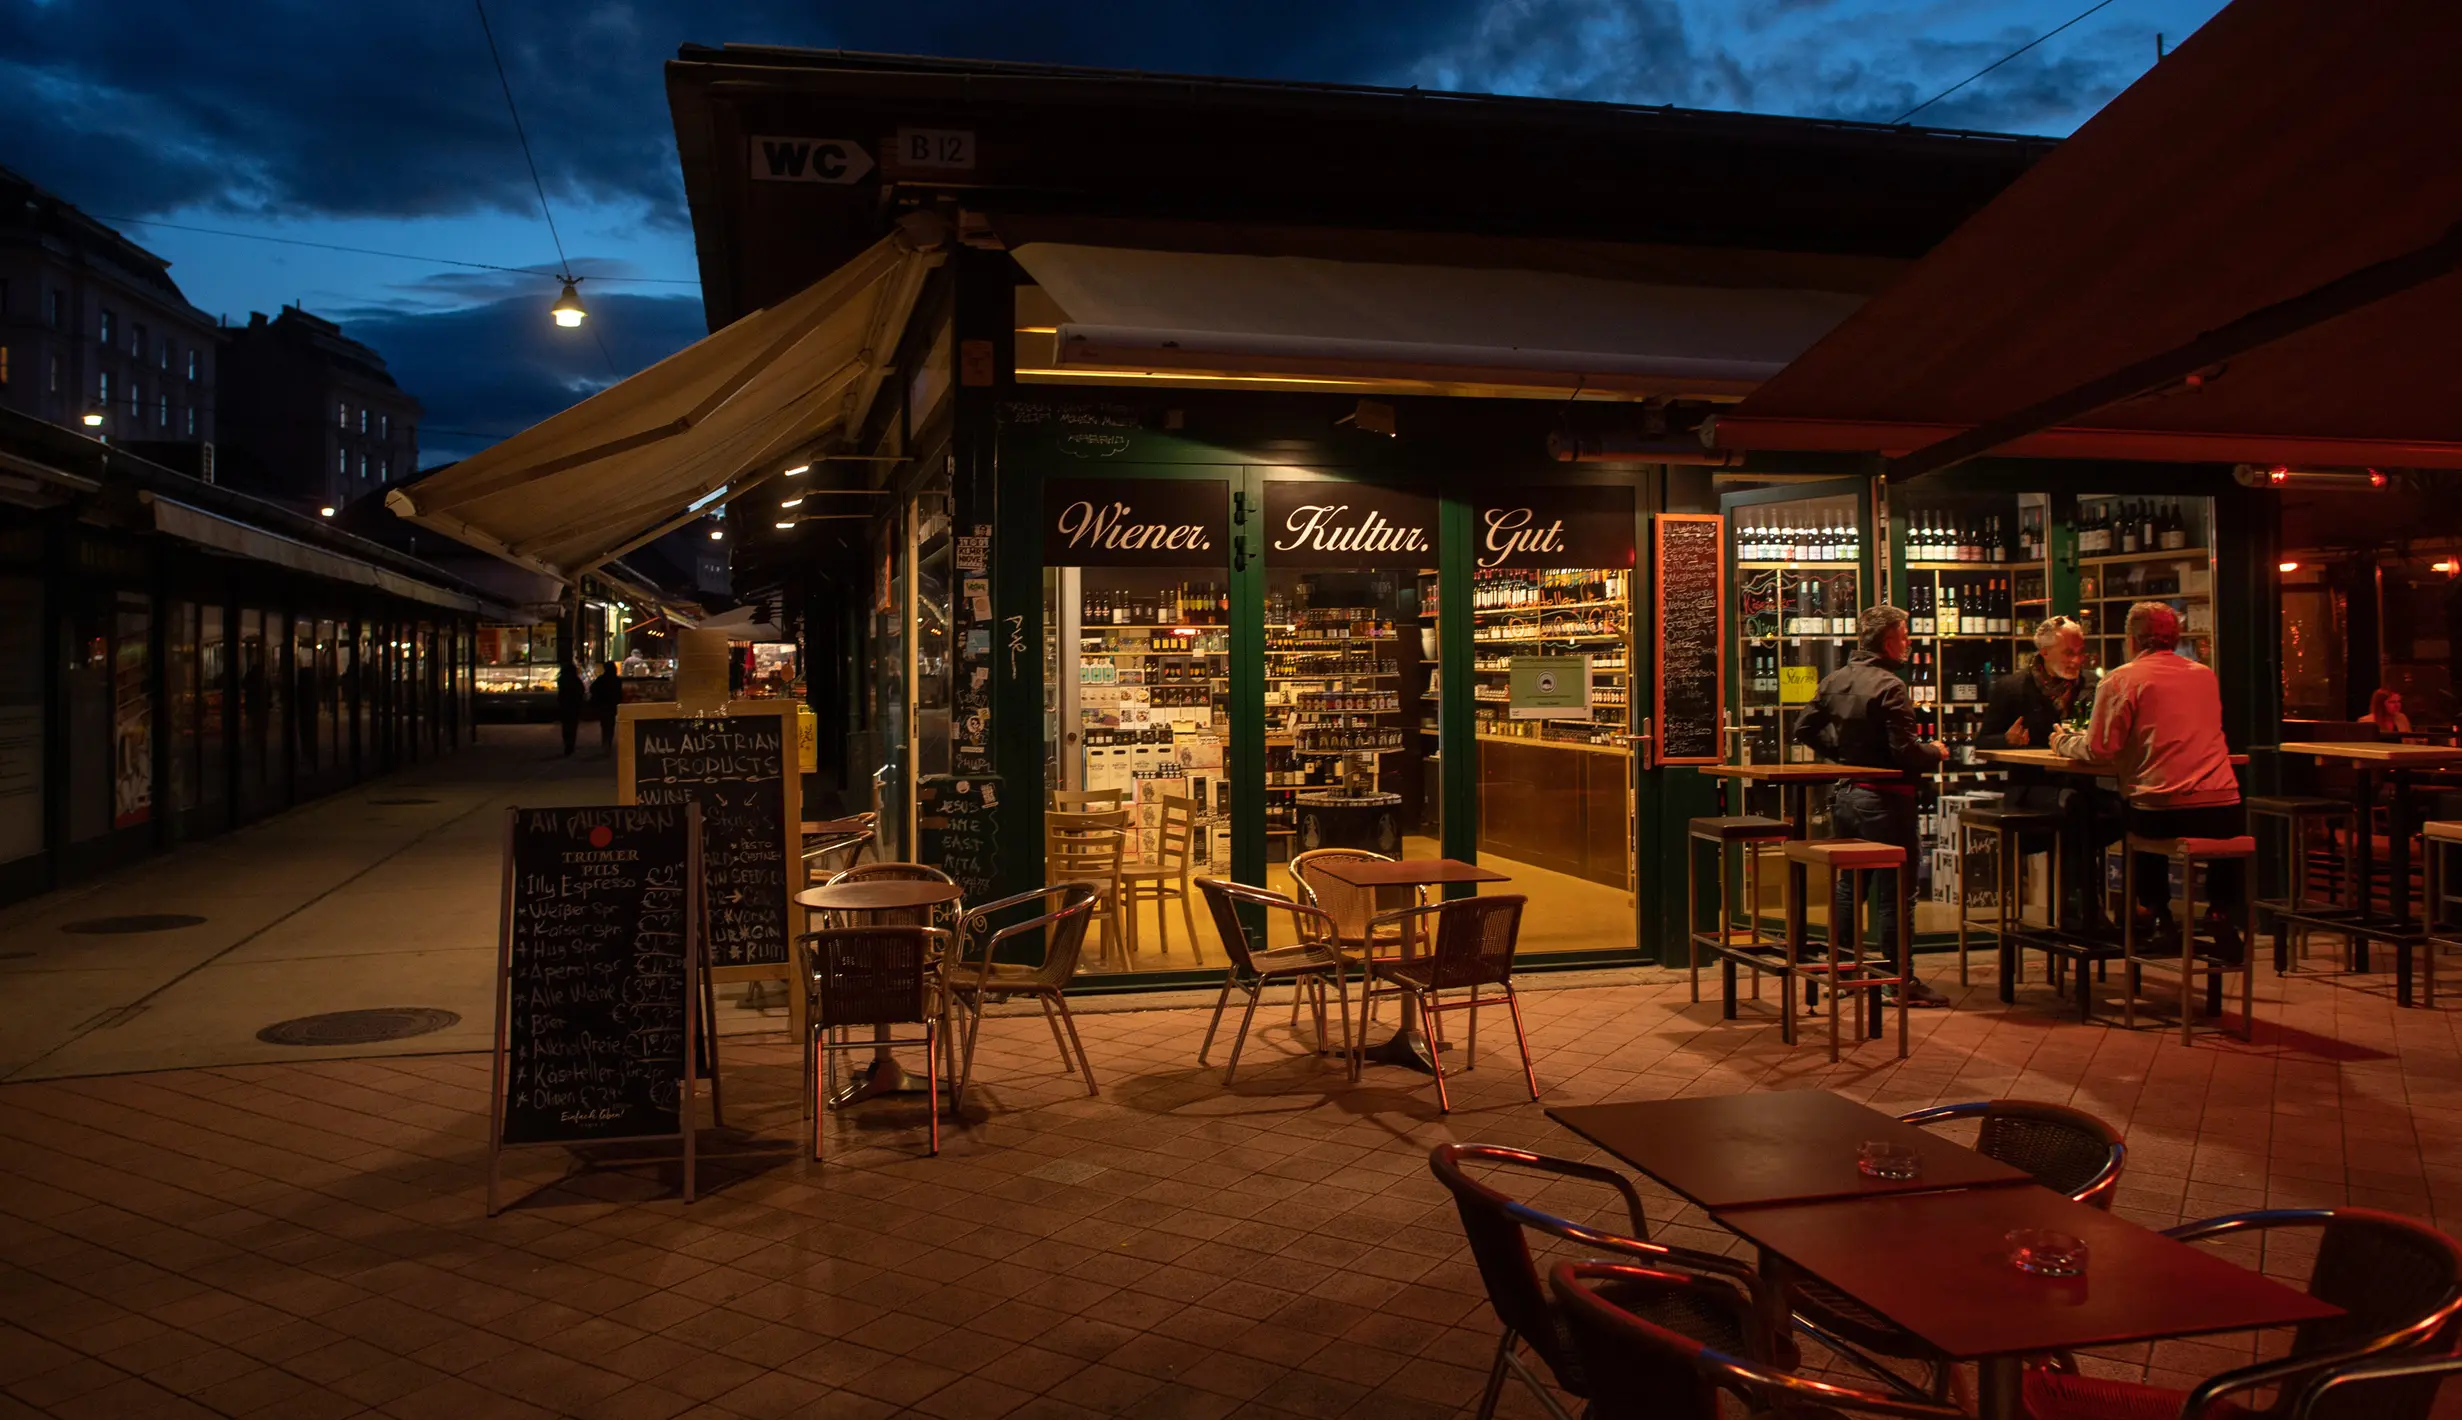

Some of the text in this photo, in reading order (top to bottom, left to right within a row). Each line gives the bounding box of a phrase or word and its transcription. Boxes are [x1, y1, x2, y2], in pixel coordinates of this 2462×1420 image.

[762, 141, 848, 179] WC
[910, 135, 965, 162] B 12
[1057, 500, 1565, 568] Wiener. Kultur. Gut.
[643, 733, 676, 755] ALL
[661, 755, 780, 776] PRODUCTS
[643, 788, 693, 806] WINE
[580, 863, 620, 877] PILS
[560, 873, 637, 900] Espresso
